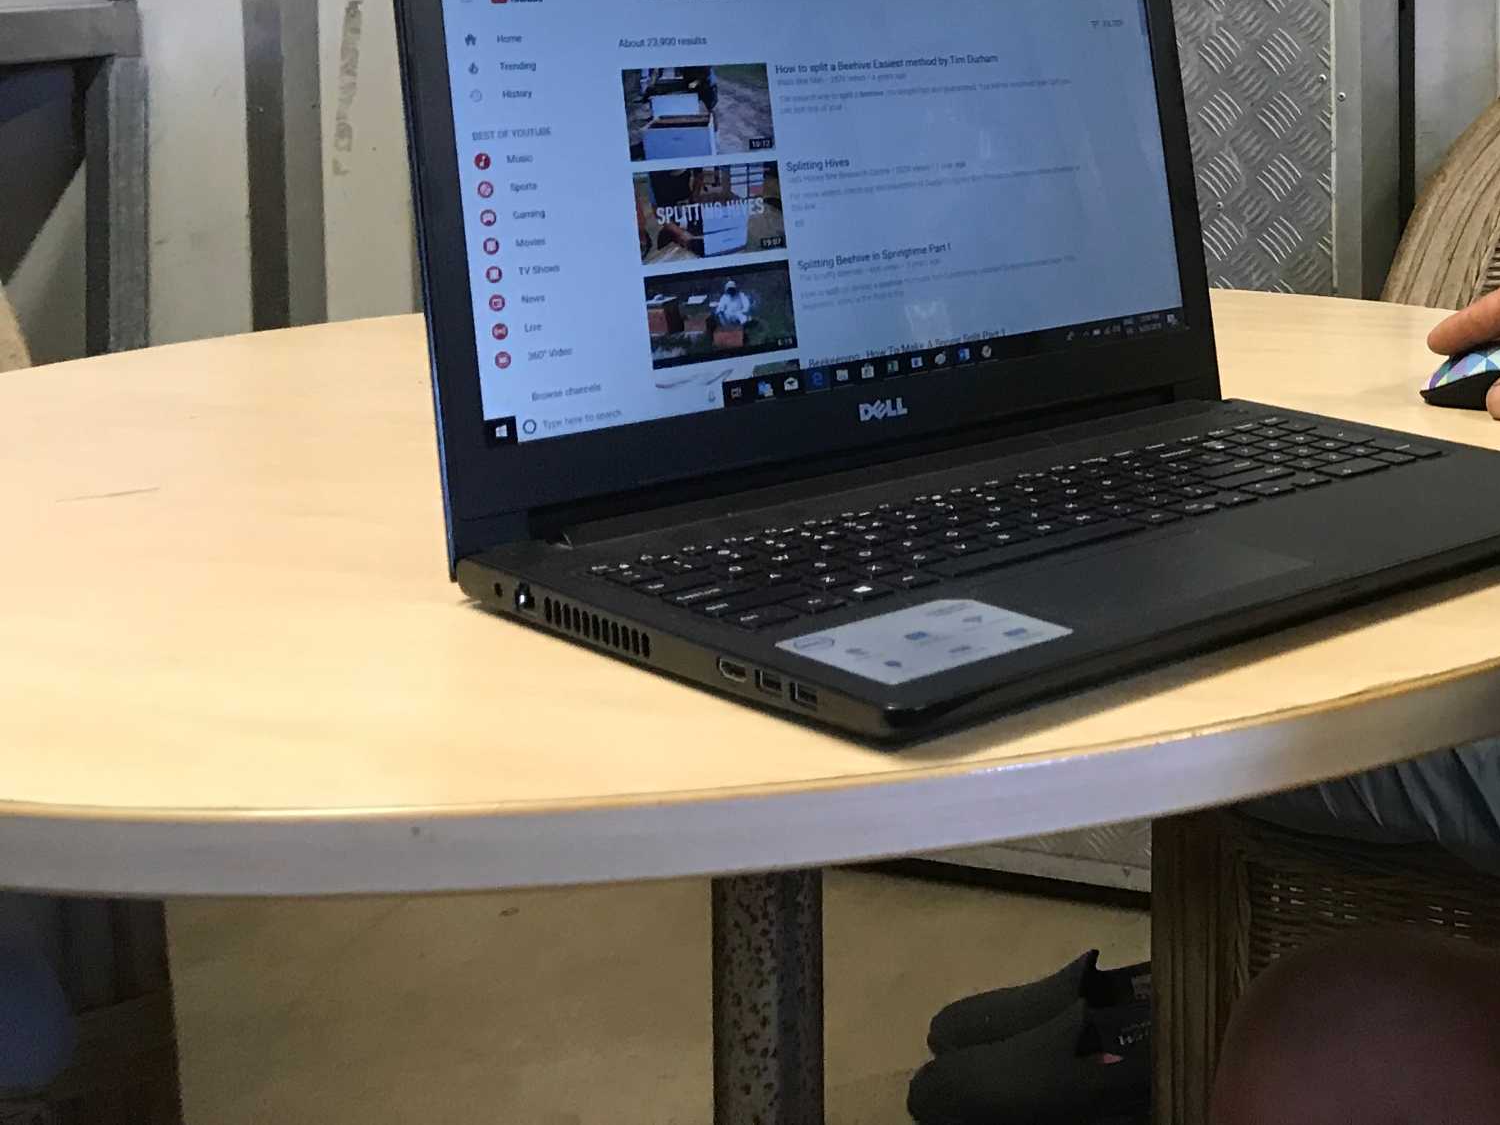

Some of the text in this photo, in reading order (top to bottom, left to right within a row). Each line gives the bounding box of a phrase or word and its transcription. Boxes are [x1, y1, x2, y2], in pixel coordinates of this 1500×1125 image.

[496, 34, 523, 44] Home
[618, 38, 645, 48] About
[500, 61, 537, 72] Trending
[775, 64, 796, 74] How
[786, 160, 823, 173] Splitting
[824, 157, 850, 168] Hives
[797, 258, 835, 272] Splitting
[858, 396, 909, 422] DELL
